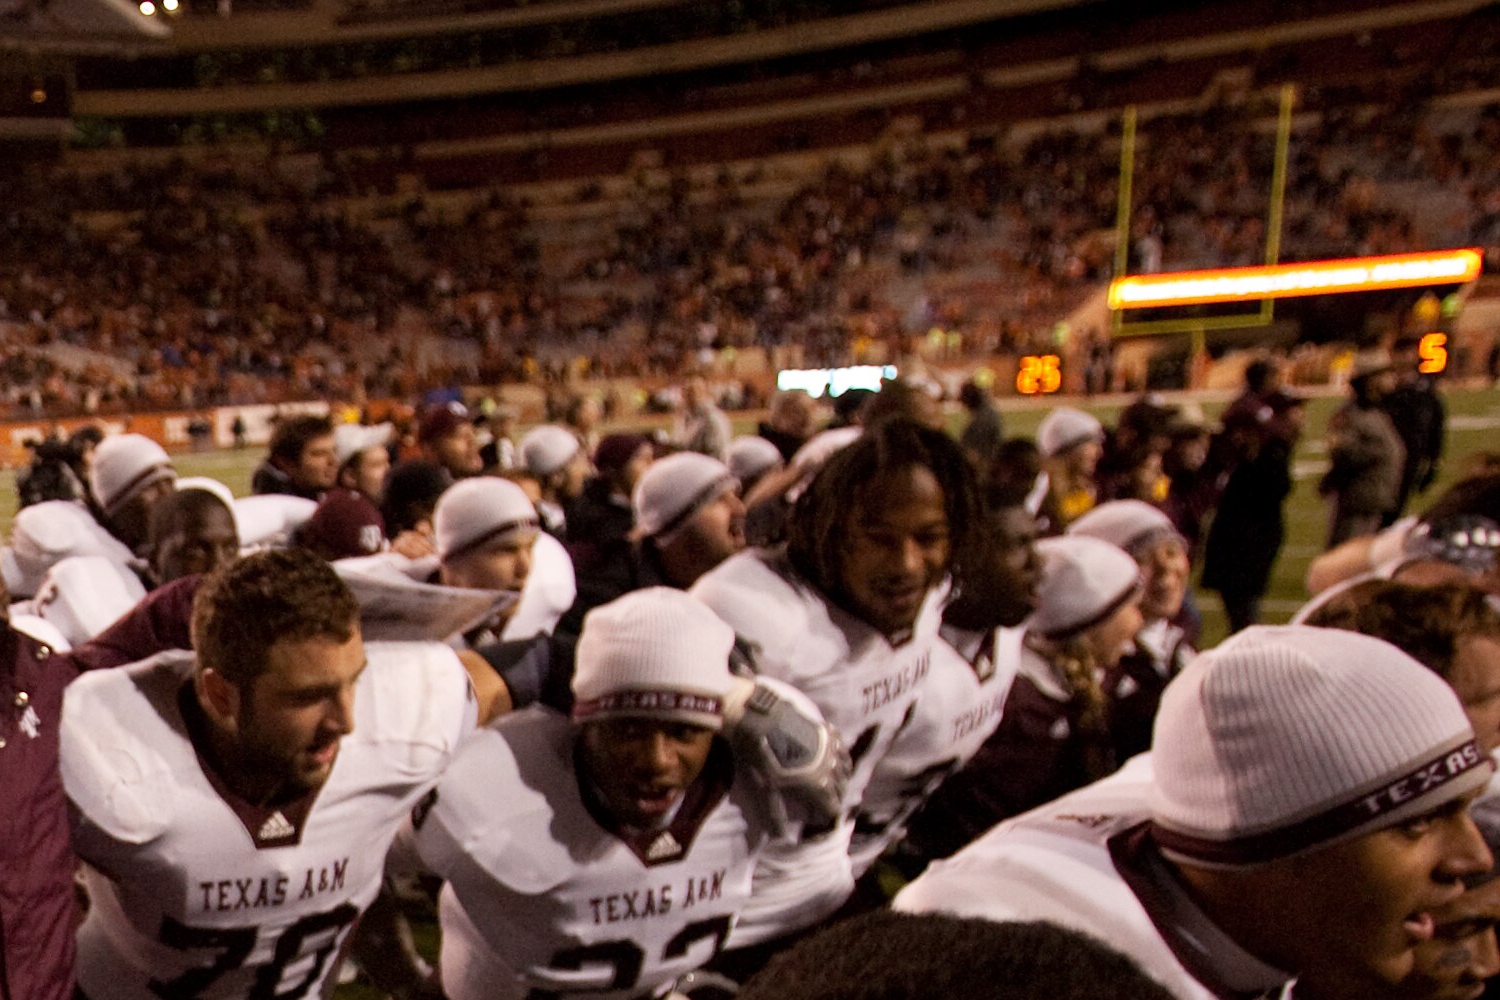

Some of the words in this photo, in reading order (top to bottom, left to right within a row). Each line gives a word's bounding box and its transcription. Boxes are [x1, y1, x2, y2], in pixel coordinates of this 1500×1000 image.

[1355, 744, 1480, 813] TEXAS
[199, 875, 289, 914] TEXAS
[299, 856, 350, 899] A&M
[590, 885, 673, 925] TEXAS
